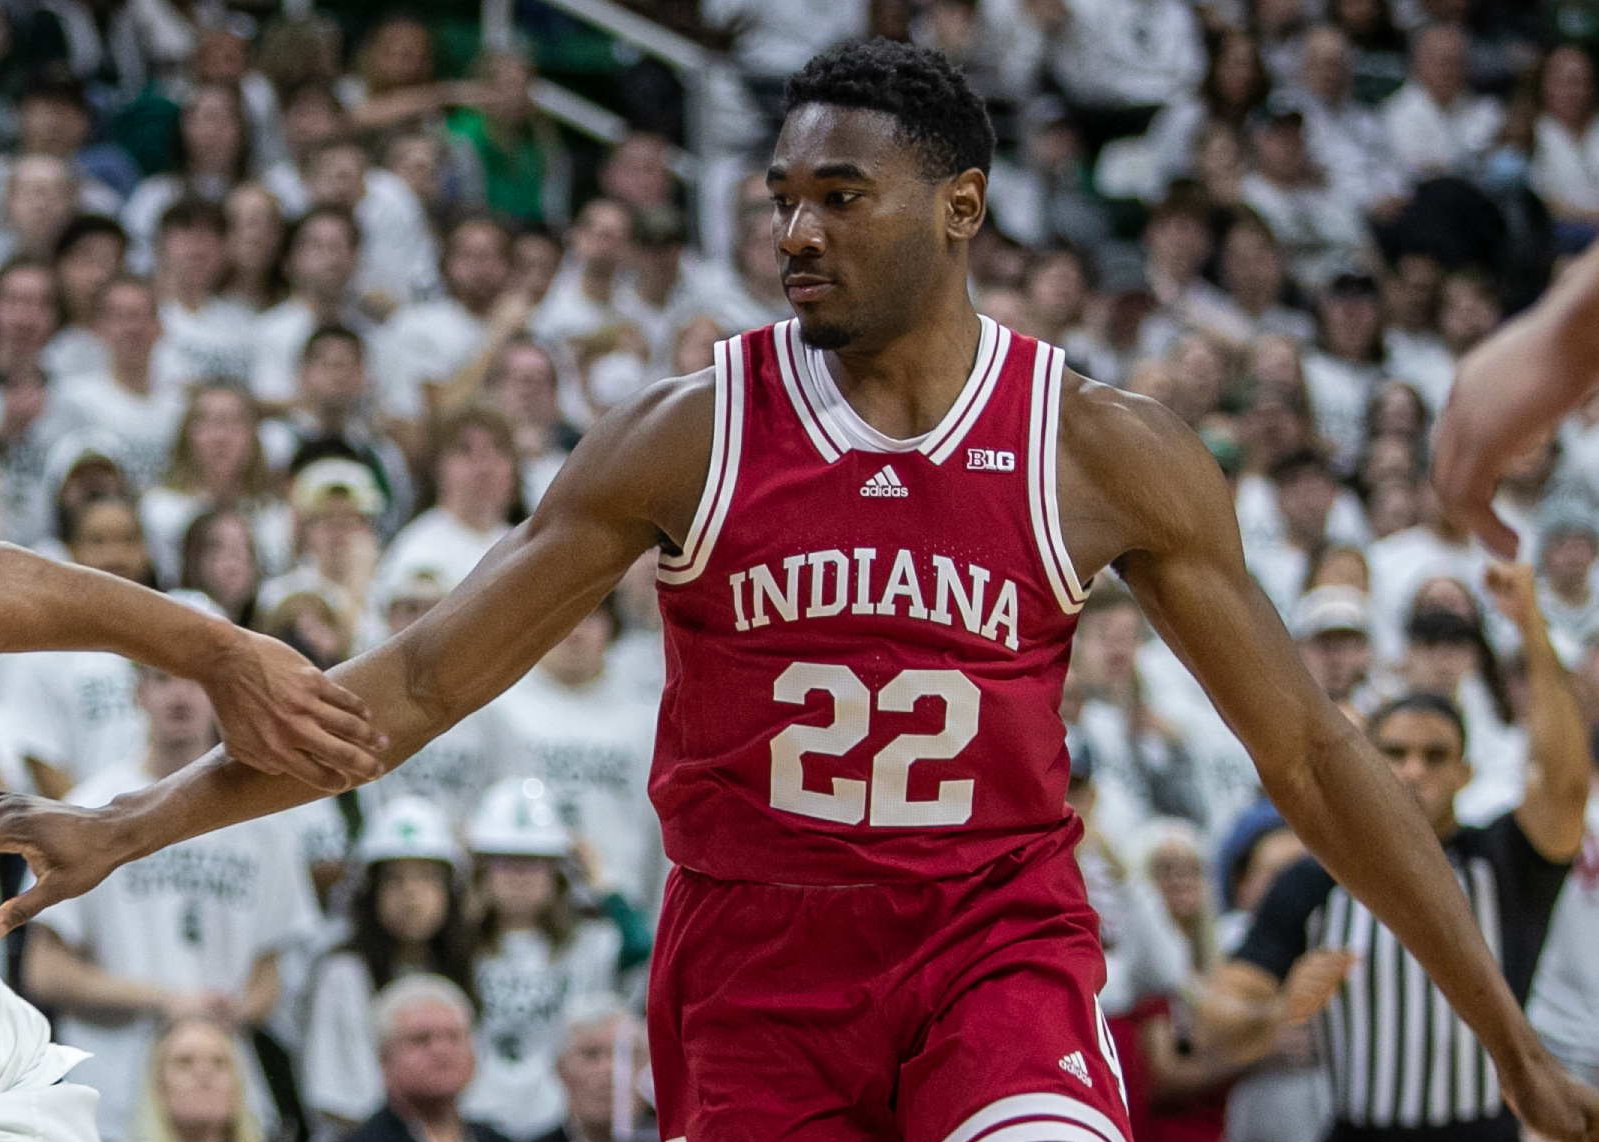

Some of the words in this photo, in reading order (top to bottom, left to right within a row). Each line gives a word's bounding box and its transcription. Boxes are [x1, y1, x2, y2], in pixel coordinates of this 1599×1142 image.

[859, 485, 909, 498] adidas
[729, 547, 1019, 652] INDIANA
[769, 661, 982, 827] 22
[1058, 1059, 1093, 1088] adidas
